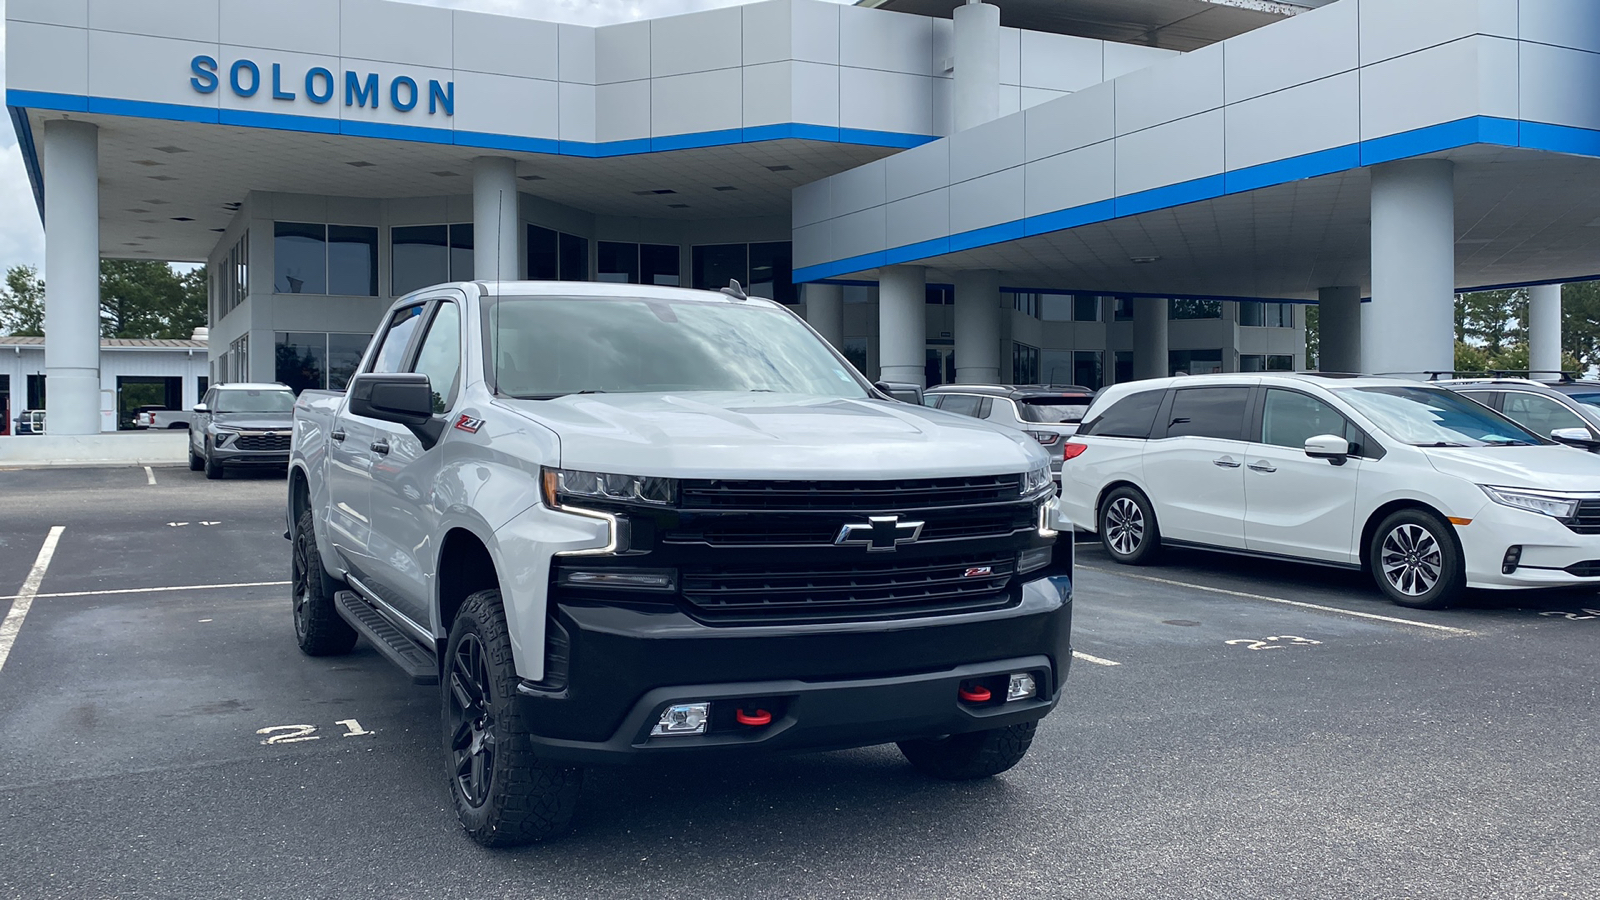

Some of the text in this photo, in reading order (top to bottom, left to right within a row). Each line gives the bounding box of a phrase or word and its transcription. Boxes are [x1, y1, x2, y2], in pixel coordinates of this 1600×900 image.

[190, 55, 454, 116] SOLOMON
[454, 414, 486, 434] Z71
[1224, 635, 1323, 650] 23
[256, 718, 375, 744] 21
